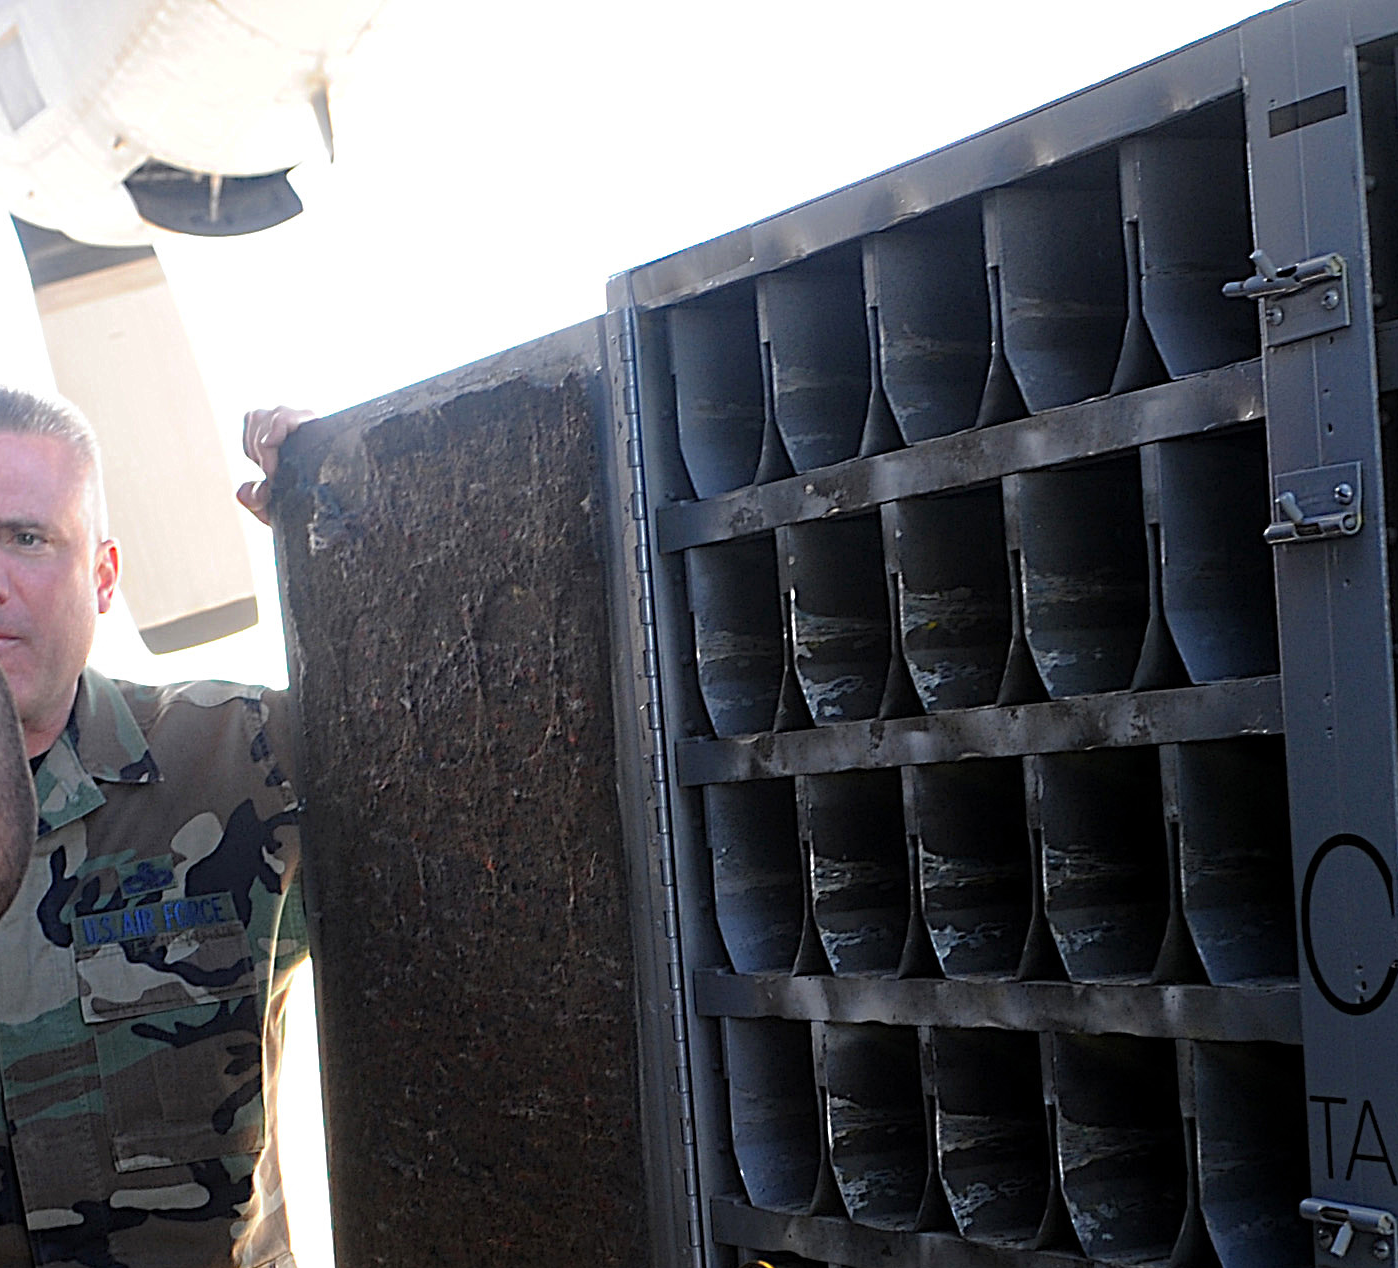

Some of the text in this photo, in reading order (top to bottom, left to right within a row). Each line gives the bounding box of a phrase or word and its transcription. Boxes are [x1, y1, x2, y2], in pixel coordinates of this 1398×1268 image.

[121, 909, 158, 938] AIR
[162, 896, 224, 932] FORCE
[1309, 1095, 1398, 1186] TA
